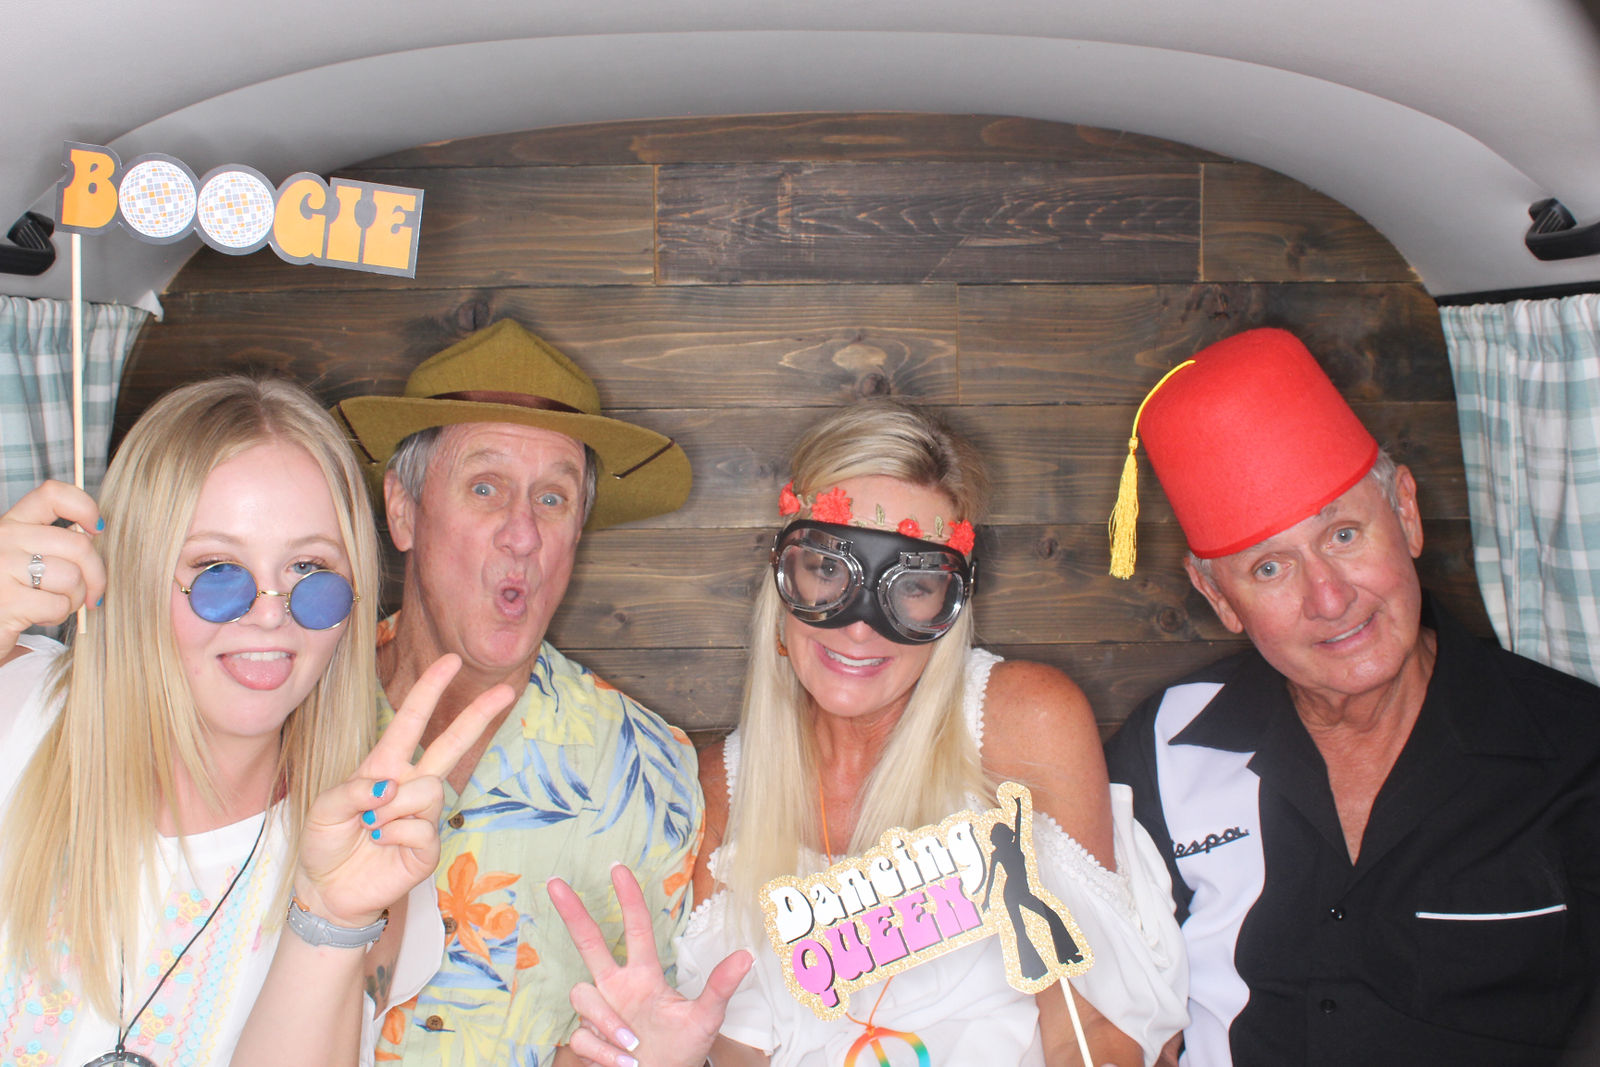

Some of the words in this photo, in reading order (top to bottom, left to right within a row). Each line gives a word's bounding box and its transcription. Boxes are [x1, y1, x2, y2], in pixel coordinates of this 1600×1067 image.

[61, 148, 416, 270] BOOGIE
[768, 821, 987, 944] Dancing
[1170, 826, 1250, 860] espa
[792, 876, 984, 1008] QUEEN
